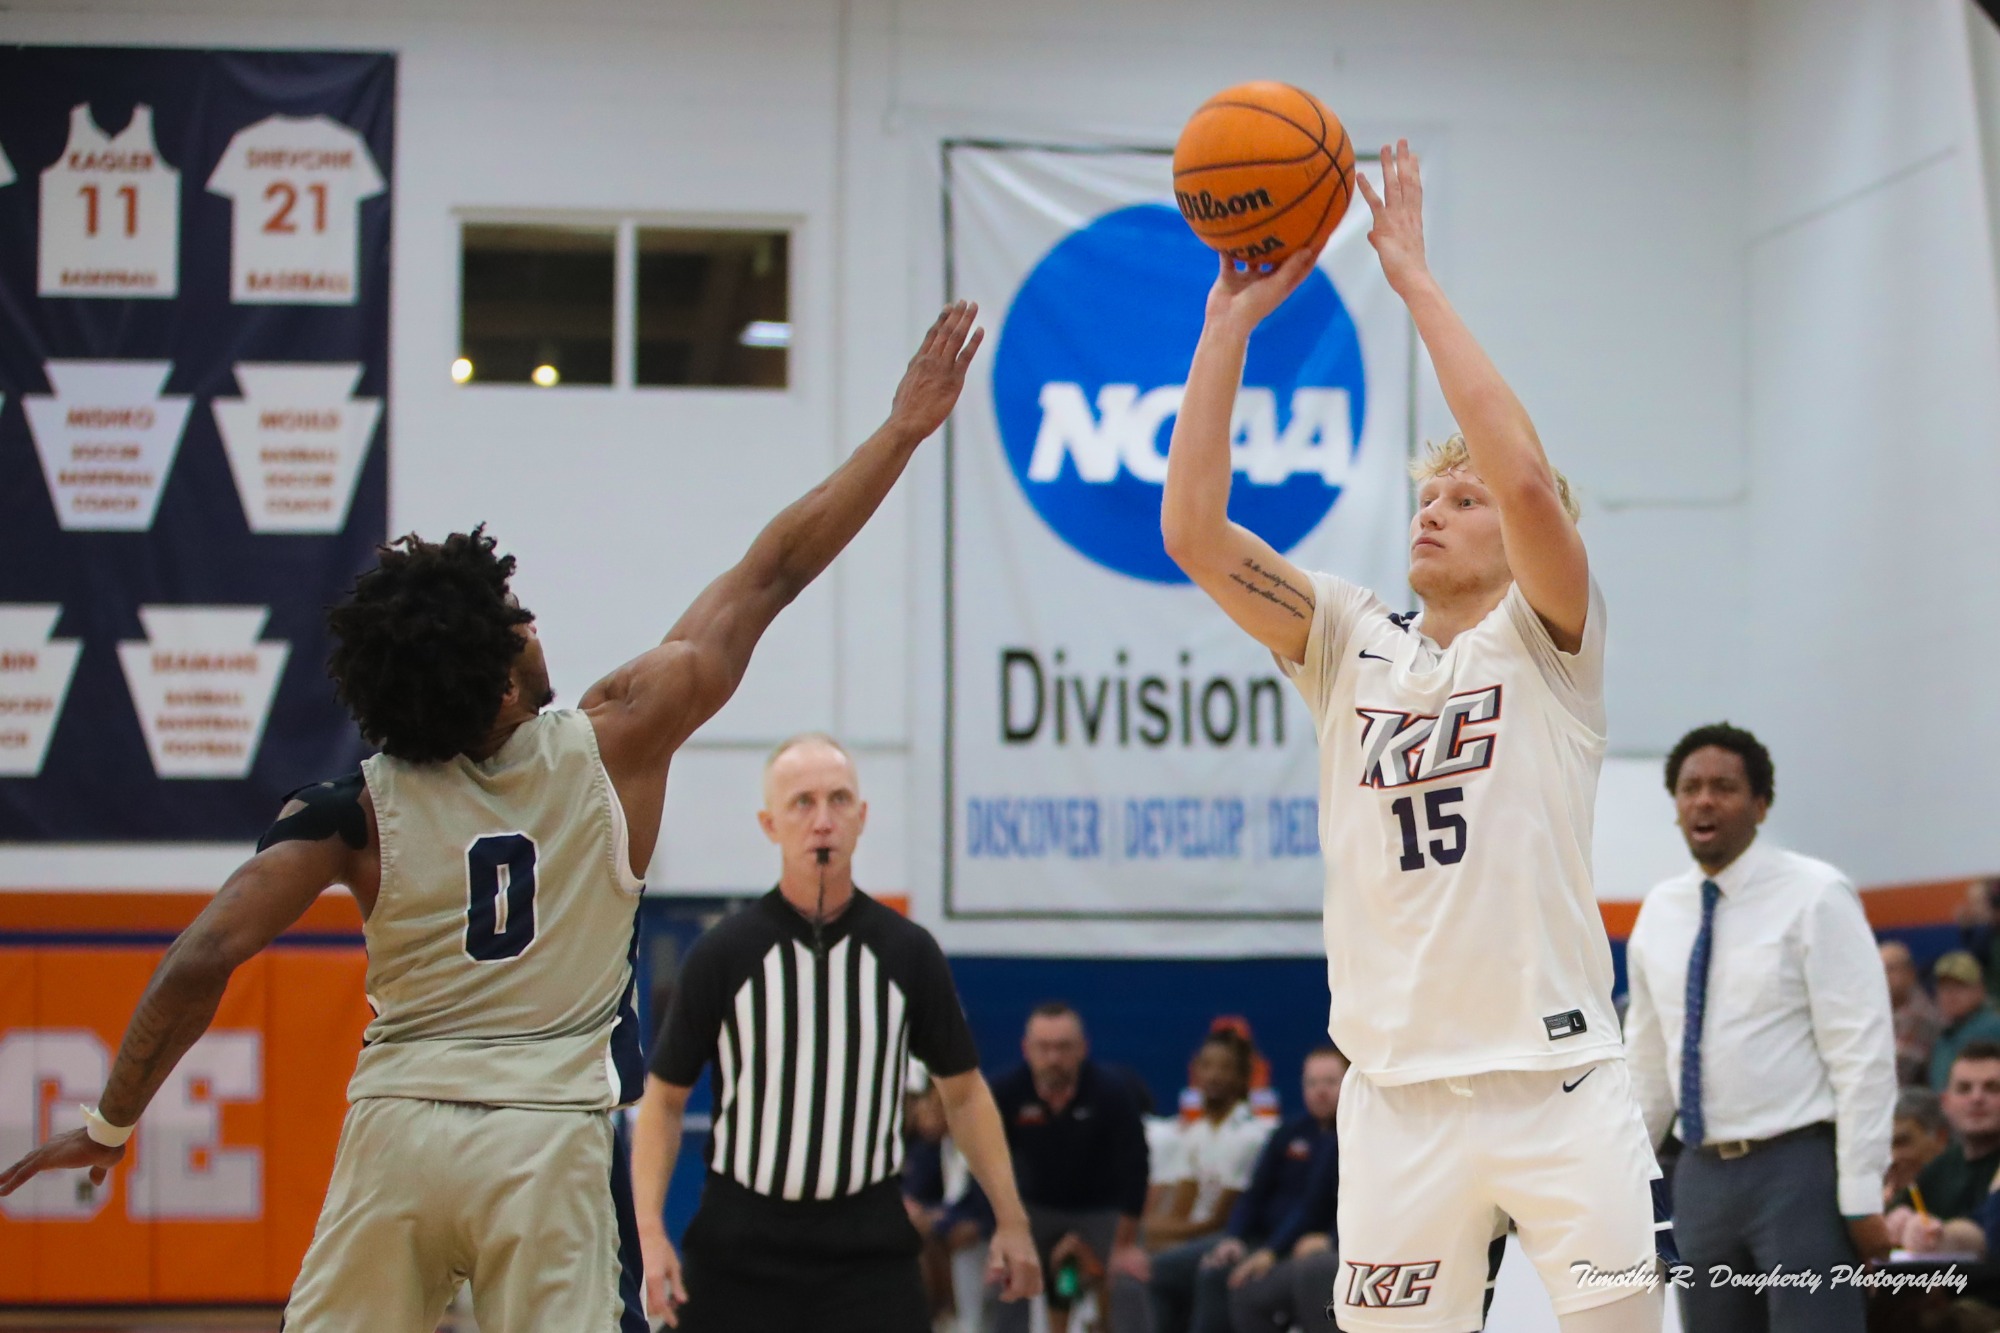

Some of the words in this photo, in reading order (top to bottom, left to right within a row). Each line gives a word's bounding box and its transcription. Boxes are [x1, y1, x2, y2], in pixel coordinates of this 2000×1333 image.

[77, 184, 138, 239] 11
[262, 180, 328, 235] 21
[1173, 187, 1274, 220] Wilson
[999, 648, 1286, 748] Division
[1355, 684, 1503, 790] KC
[966, 796, 1101, 860] DISCOVER
[1123, 796, 1247, 860] DEVELOP
[1391, 786, 1468, 873] 15
[462, 830, 541, 965] 0
[1344, 1259, 1441, 1309] KC
